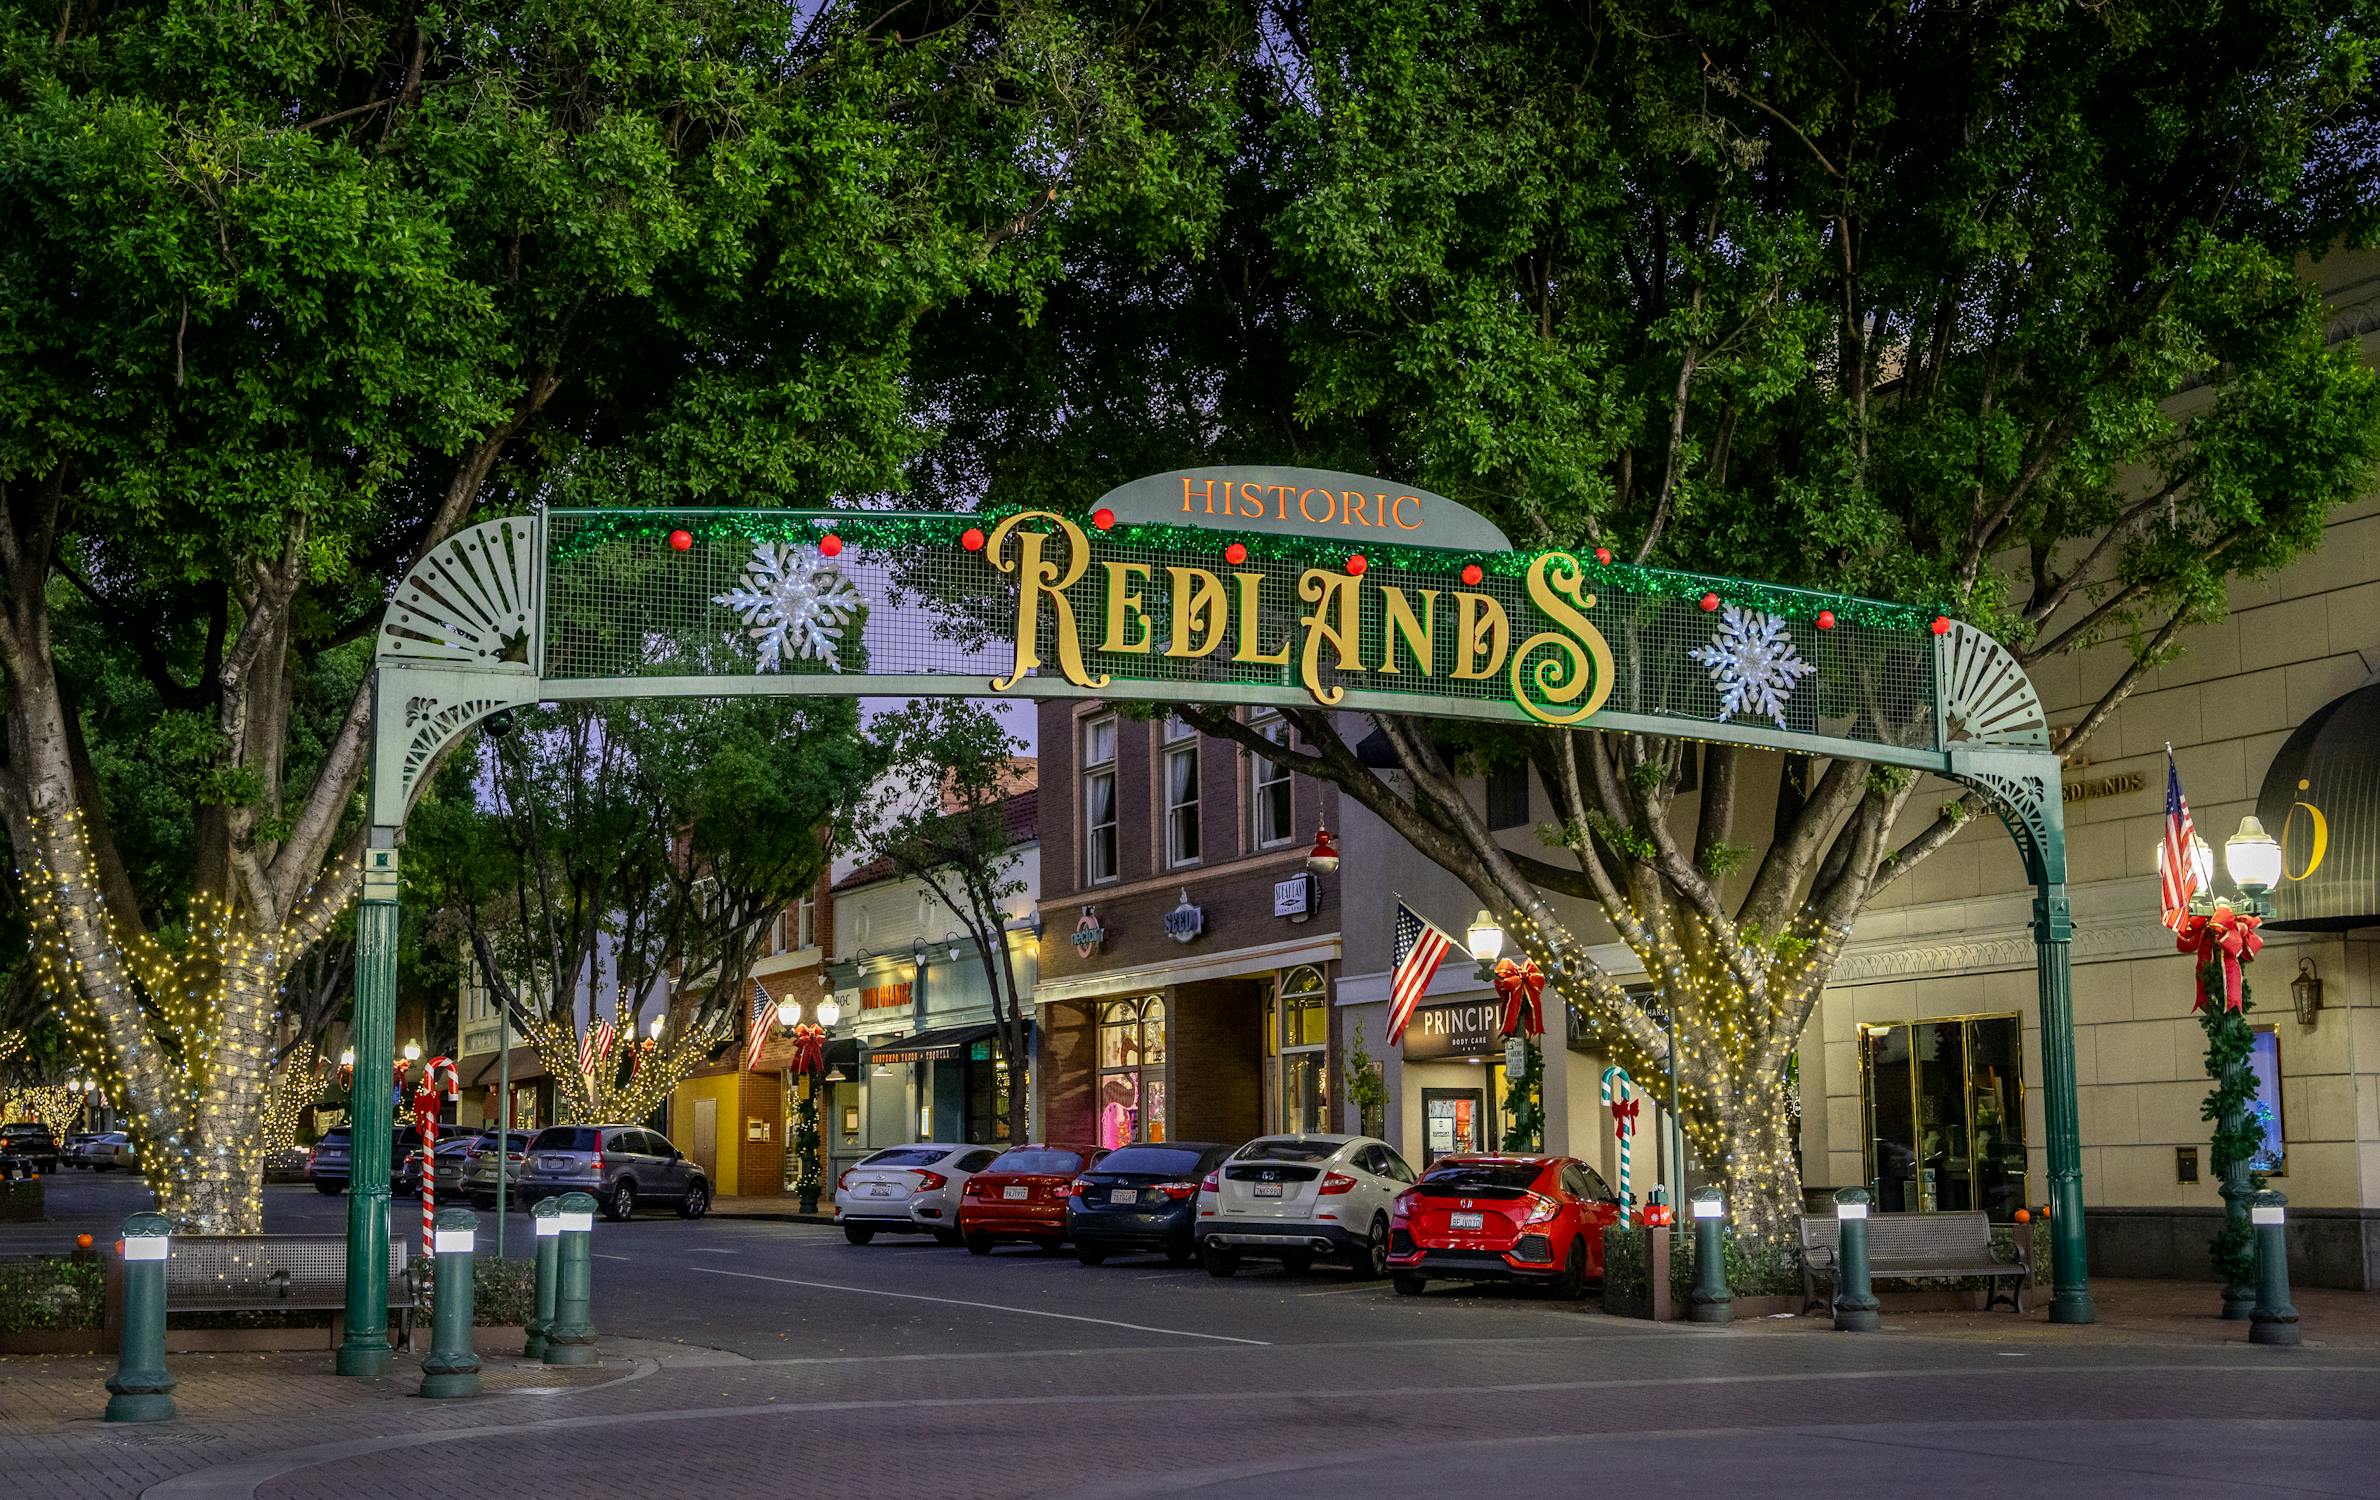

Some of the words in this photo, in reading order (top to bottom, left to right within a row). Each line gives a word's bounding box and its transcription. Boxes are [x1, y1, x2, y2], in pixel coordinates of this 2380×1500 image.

[1179, 477, 1425, 531] HISTORIC
[986, 510, 1616, 724] REDLANDS
[1452, 1038, 1469, 1046] BODY
